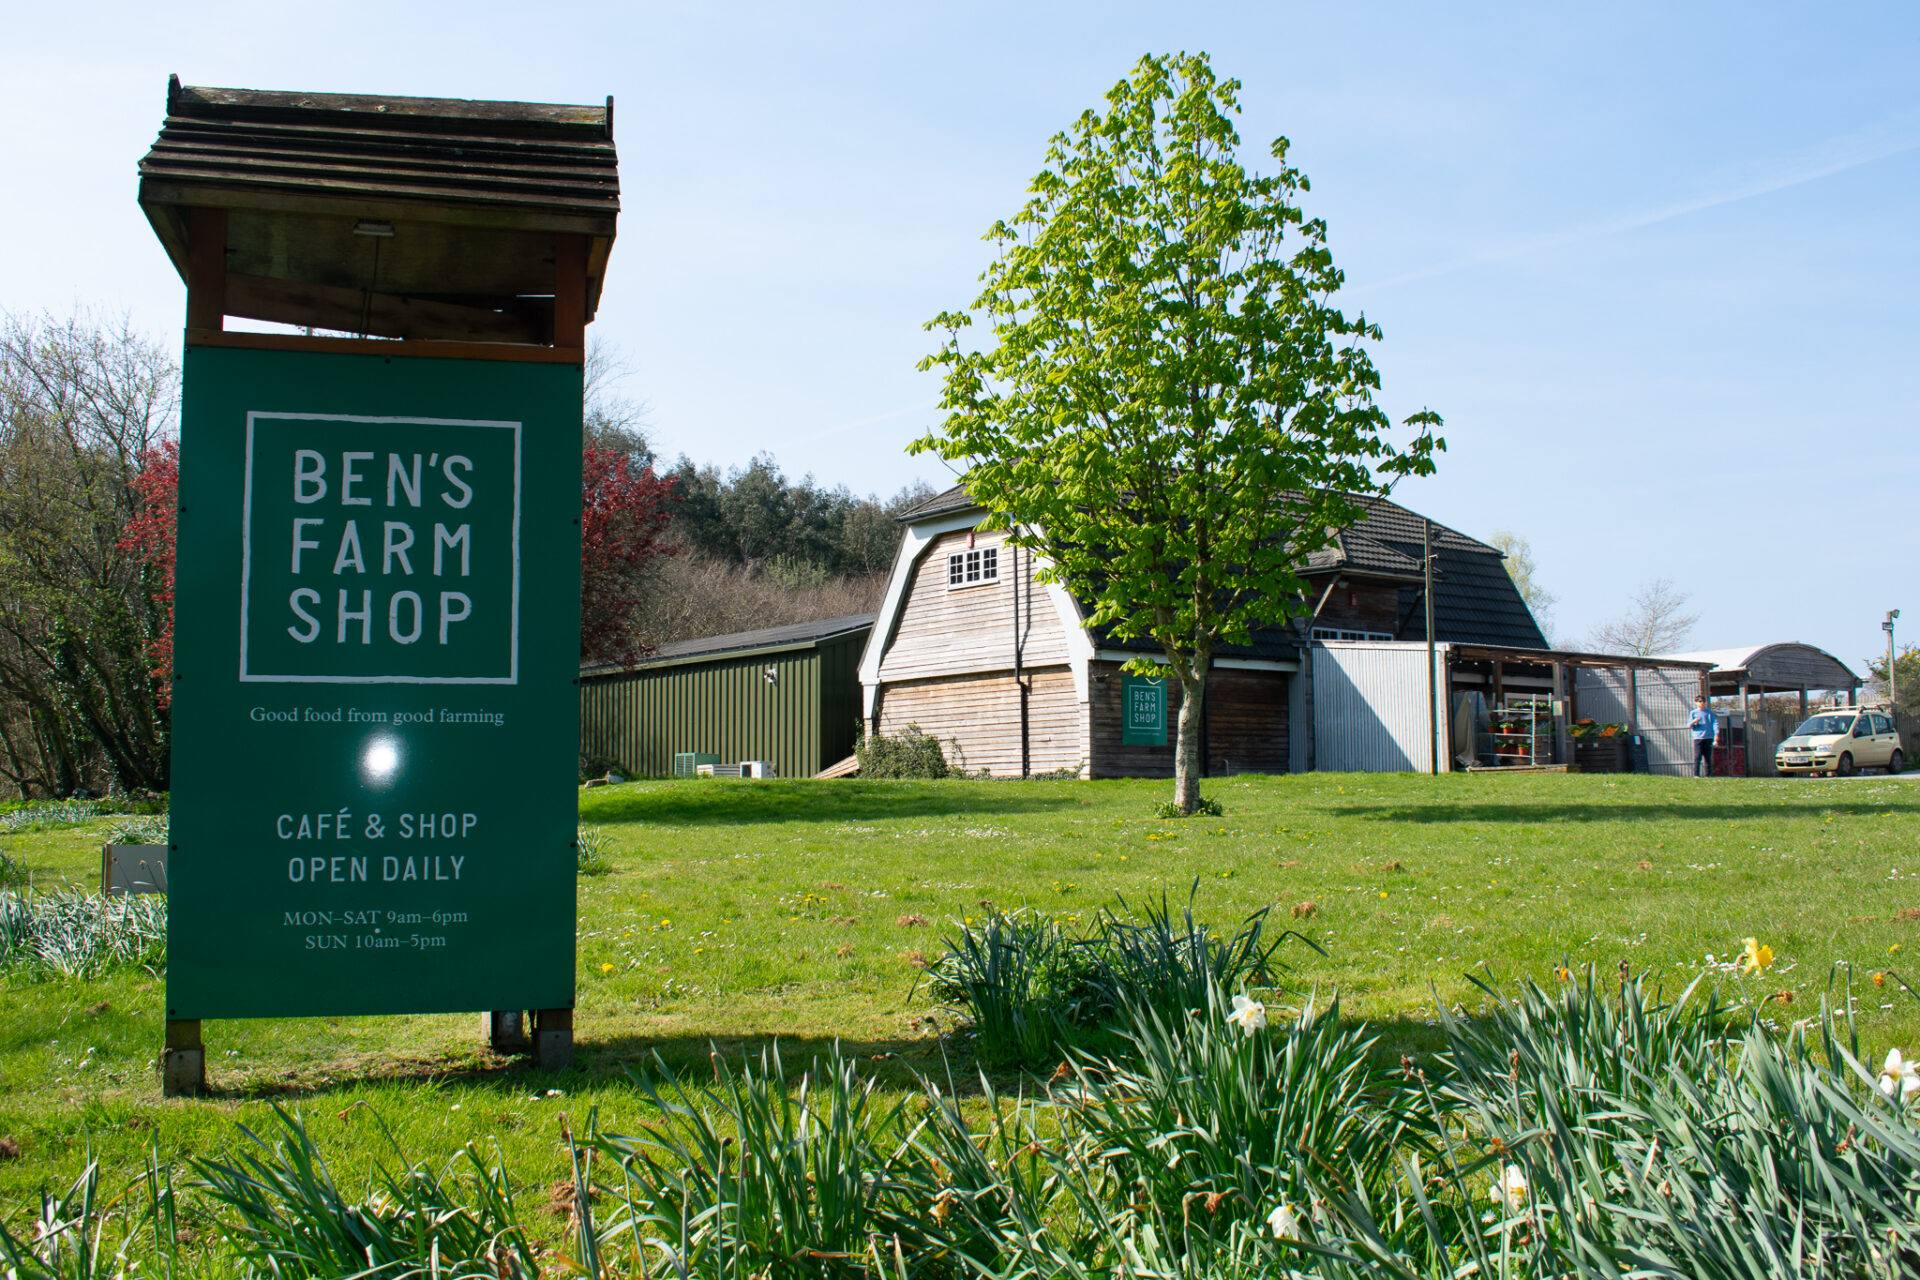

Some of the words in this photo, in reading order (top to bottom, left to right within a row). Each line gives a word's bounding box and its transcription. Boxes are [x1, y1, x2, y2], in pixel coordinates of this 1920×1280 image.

[293, 448, 474, 510] BEN'S
[291, 517, 471, 577] FARM
[287, 587, 473, 645] SHOP
[249, 706, 299, 722] Good
[303, 706, 342, 722] food
[347, 706, 388, 723] from
[392, 708, 434, 726] good
[439, 708, 505, 726] farming
[1134, 702, 1156, 712] FARM
[1134, 713, 1156, 723] SHOP
[276, 806, 352, 840] CAFÉ
[364, 813, 386, 840] &
[398, 812, 478, 840] SHOP
[288, 856, 368, 883] OPEN
[382, 855, 466, 882] DAILY
[305, 934, 348, 950] SUN
